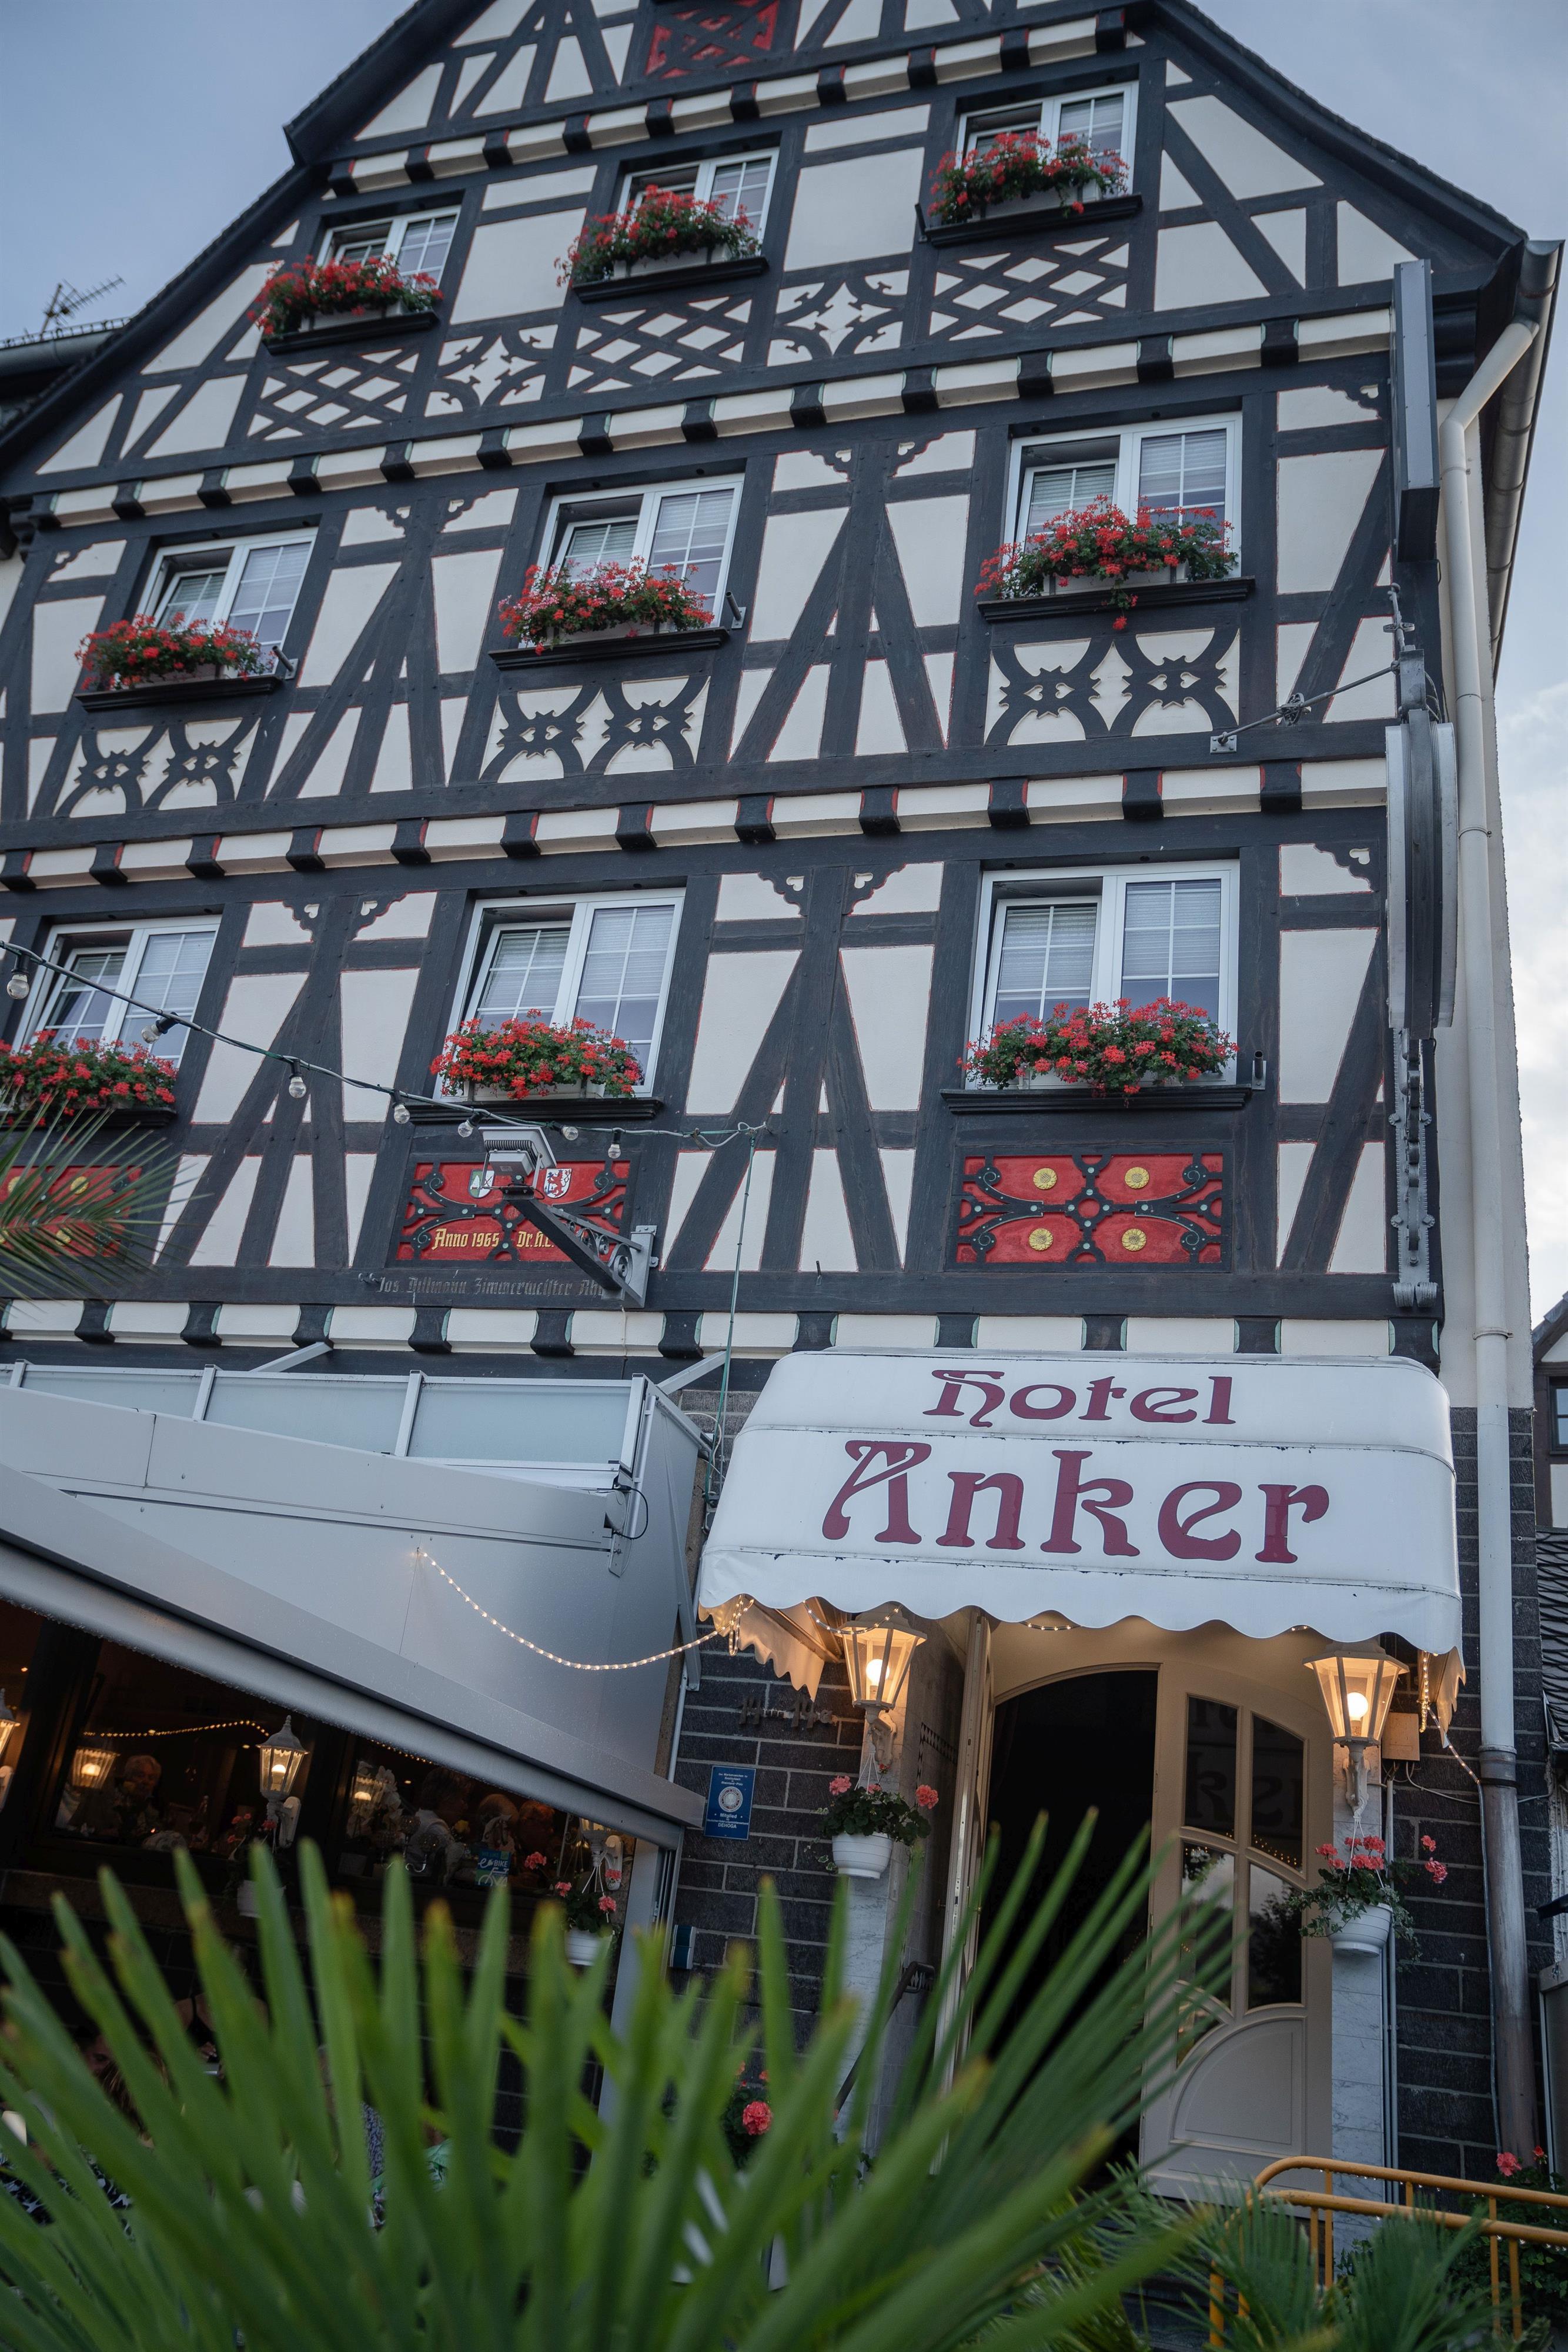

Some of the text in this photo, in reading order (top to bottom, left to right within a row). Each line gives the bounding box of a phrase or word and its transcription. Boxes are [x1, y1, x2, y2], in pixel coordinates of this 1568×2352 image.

[432, 1228, 469, 1250] Anno
[472, 1232, 500, 1247] 1965
[823, 1441, 1329, 1563] Anker
[494, 1859, 509, 1868] BIKE
